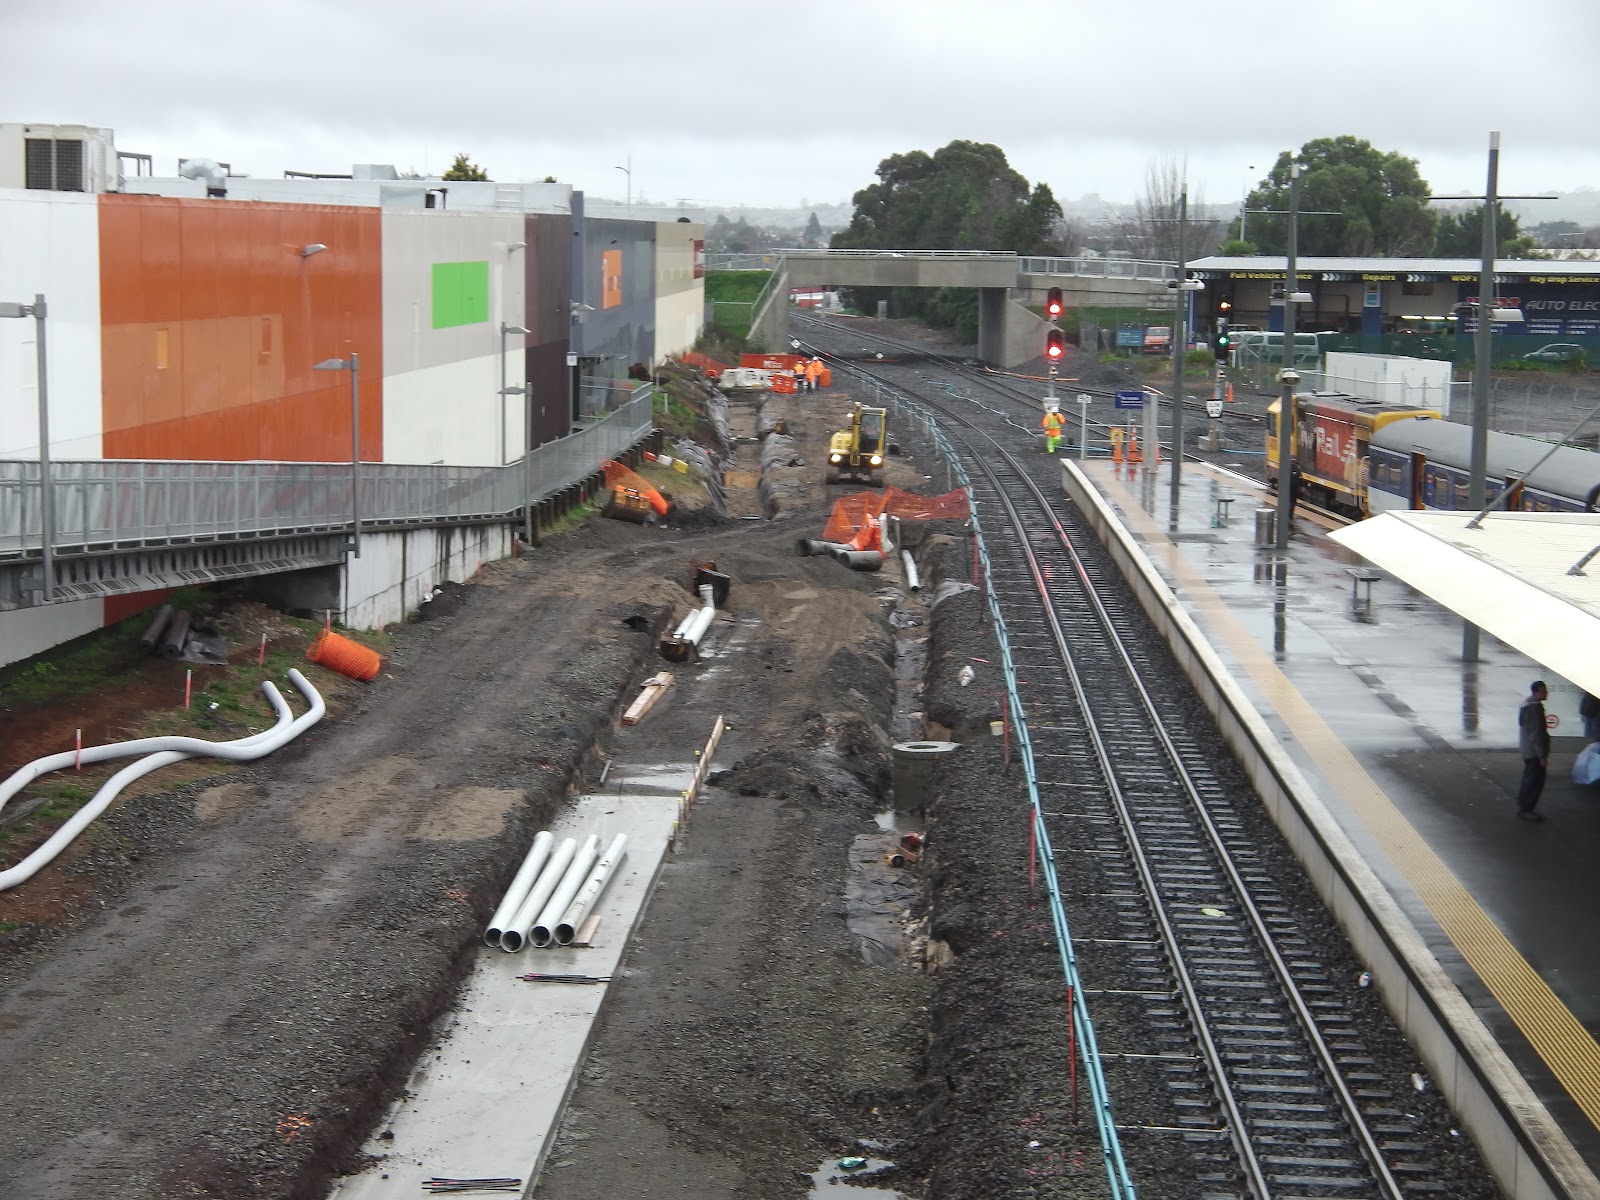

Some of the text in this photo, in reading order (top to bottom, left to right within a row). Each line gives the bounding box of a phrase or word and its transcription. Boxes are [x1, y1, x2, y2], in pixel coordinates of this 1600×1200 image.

[1248, 272, 1281, 280] Vehicle
[1282, 272, 1313, 281] Svice
[1362, 273, 1397, 282] Repairs
[1525, 300, 1566, 310] AUTO
